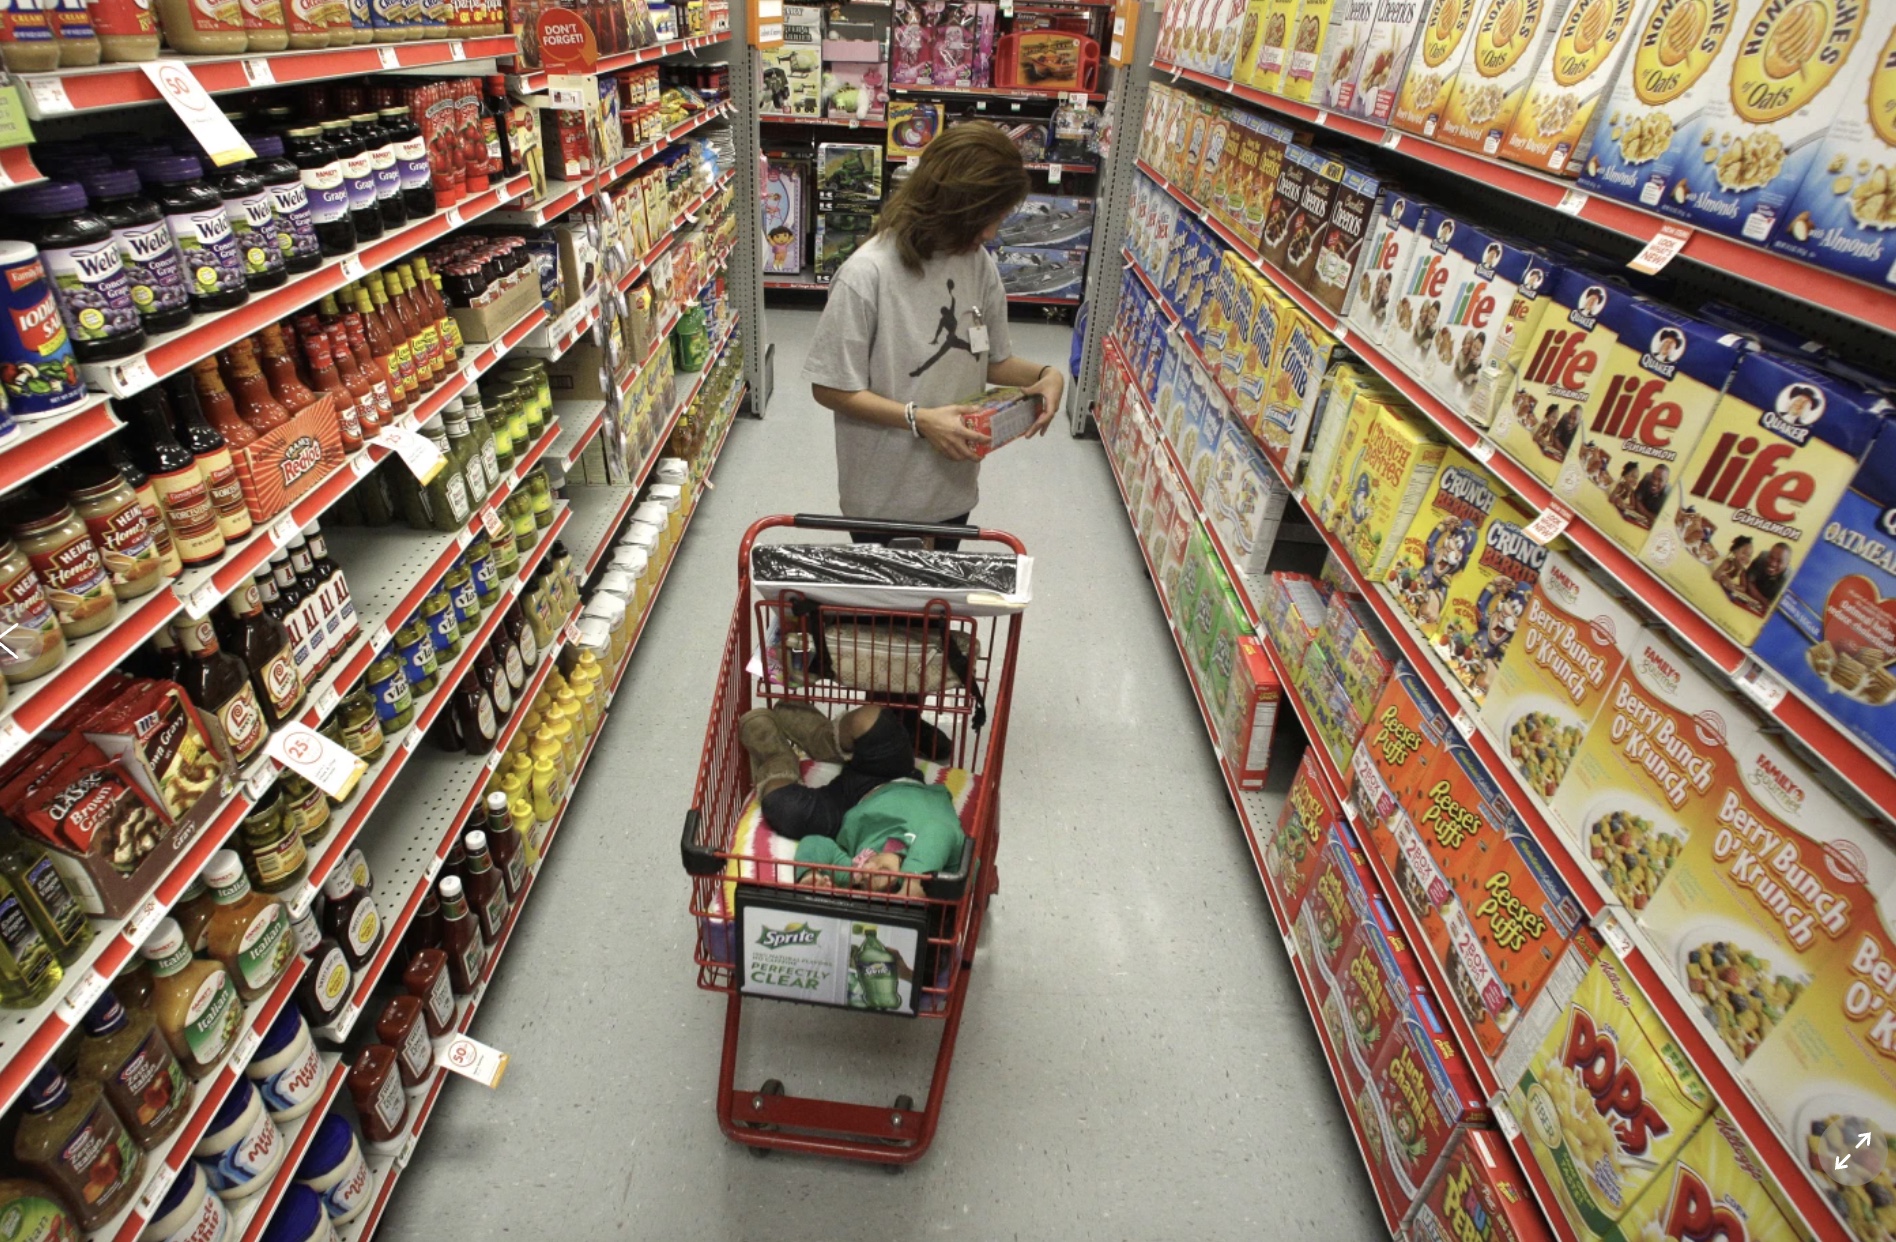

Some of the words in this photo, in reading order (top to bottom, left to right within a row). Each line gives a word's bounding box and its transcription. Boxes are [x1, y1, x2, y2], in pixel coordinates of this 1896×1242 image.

[543, 33, 584, 46] FORGET!
[545, 23, 577, 36] DON'T
[1483, 49, 1506, 68] Oats
[1561, 56, 1588, 75] Oats
[166, 77, 190, 95] 50
[1645, 69, 1681, 93] Oats
[1748, 83, 1794, 110] Oats
[1277, 172, 1302, 201] Cheerios
[1602, 167, 1639, 188] Almonds
[1301, 185, 1328, 217] Cheerios
[1332, 202, 1363, 236] Cheerios
[1693, 192, 1741, 220] Almonds
[1367, 231, 1399, 271] life
[1640, 250, 1665, 266] NEW!
[1658, 238, 1676, 248] LOOK
[1819, 227, 1884, 262] Almonds
[1406, 254, 1449, 298] life
[1447, 281, 1496, 329] life
[1508, 299, 1529, 320] life
[1570, 311, 1597, 329] QUAKER
[1290, 327, 1314, 369] HONEY
[1523, 329, 1598, 391] life
[1641, 354, 1675, 378] QUAKER
[1281, 346, 1308, 399] COMB
[1590, 374, 1684, 447] life
[1763, 413, 1810, 443] QUAKER
[1368, 420, 1412, 469] CRUNCH
[1621, 437, 1678, 462] Cinnamon
[1440, 466, 1497, 516] CRUNCH
[1690, 432, 1816, 523] life
[1731, 508, 1803, 541] Cinnamon
[60, 539, 92, 565] HEINZ
[1487, 520, 1549, 569] CRUNC
[1530, 597, 1565, 633] Berry
[1561, 625, 1607, 685] Bunch
[1525, 629, 1587, 701] O'Krunch
[160, 712, 185, 745] Gravy
[1374, 728, 1408, 766] Puffs
[1381, 705, 1423, 751] Reese's
[1615, 681, 1662, 735] Berry
[1657, 719, 1713, 790] Bunch
[288, 739, 309, 759] 25
[1611, 714, 1689, 806] O'Krunch
[1359, 762, 1368, 777] 2
[1366, 769, 1381, 790] BOX
[70, 785, 112, 824] Brown
[1429, 780, 1482, 836] Reese's
[1422, 804, 1466, 849] Puffs
[1406, 839, 1416, 855] 2
[1414, 846, 1433, 876] BOX
[1719, 790, 1781, 856] Berry
[1773, 840, 1851, 935] Bunch
[1485, 871, 1546, 938] Reese's
[1713, 828, 1816, 947] O'Krunch
[249, 921, 282, 960] Italian
[764, 930, 815, 947] Sprite
[1476, 898, 1526, 951] Puffs
[751, 962, 831, 980] PERFECTLY
[1458, 934, 1470, 951] 2
[1468, 946, 1488, 975] BOX
[751, 971, 820, 990] CLEAR
[1601, 962, 1632, 1008] Kellogg's
[196, 989, 229, 1034] Italian
[454, 1047, 466, 1063] 50
[1390, 1058, 1426, 1131] Charms
[1401, 1045, 1429, 1112] Lucky
[1715, 1118, 1763, 1181] Kellogg's
